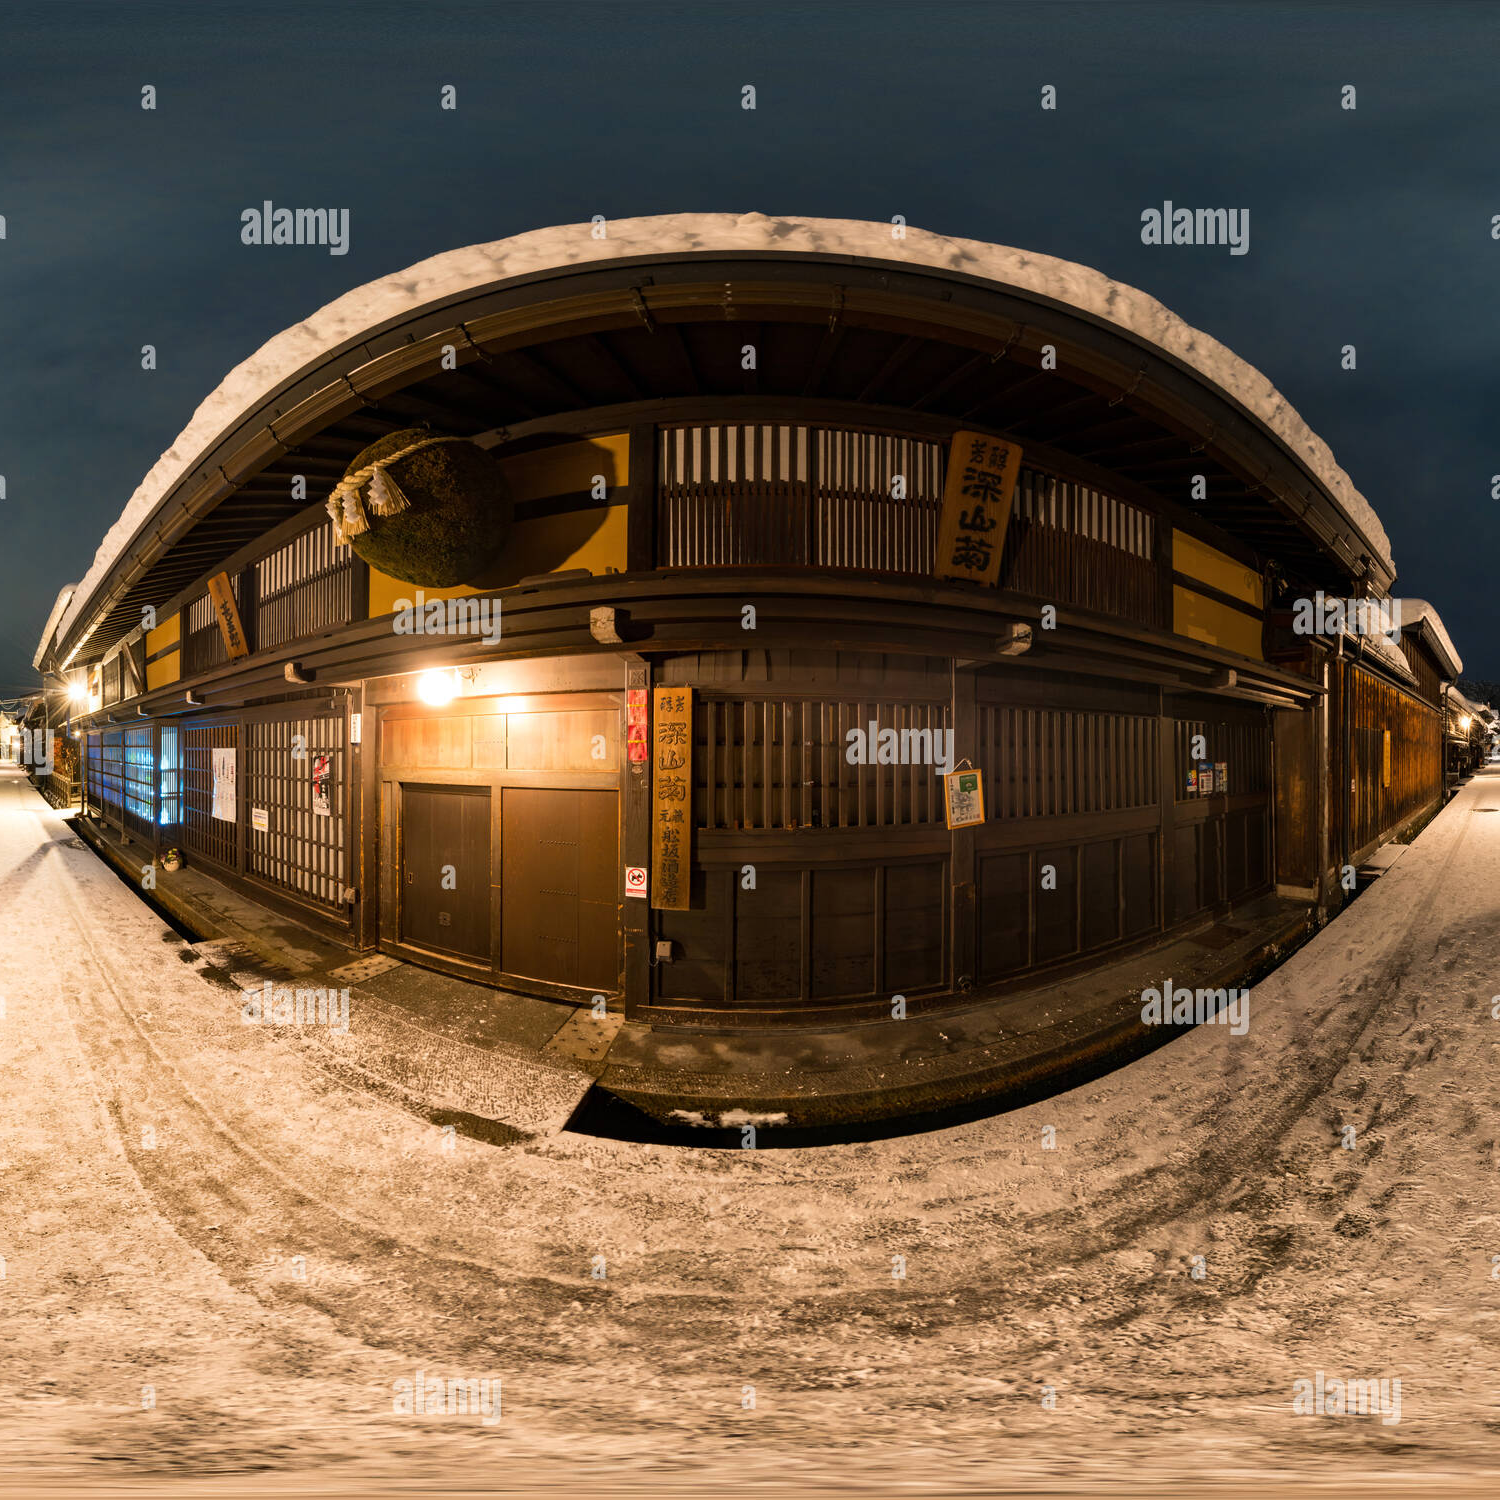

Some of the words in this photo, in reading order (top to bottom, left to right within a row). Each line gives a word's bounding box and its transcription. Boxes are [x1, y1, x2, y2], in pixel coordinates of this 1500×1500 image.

[951, 467, 1005, 572] 深山菊
[659, 721, 687, 801] 深山菊
